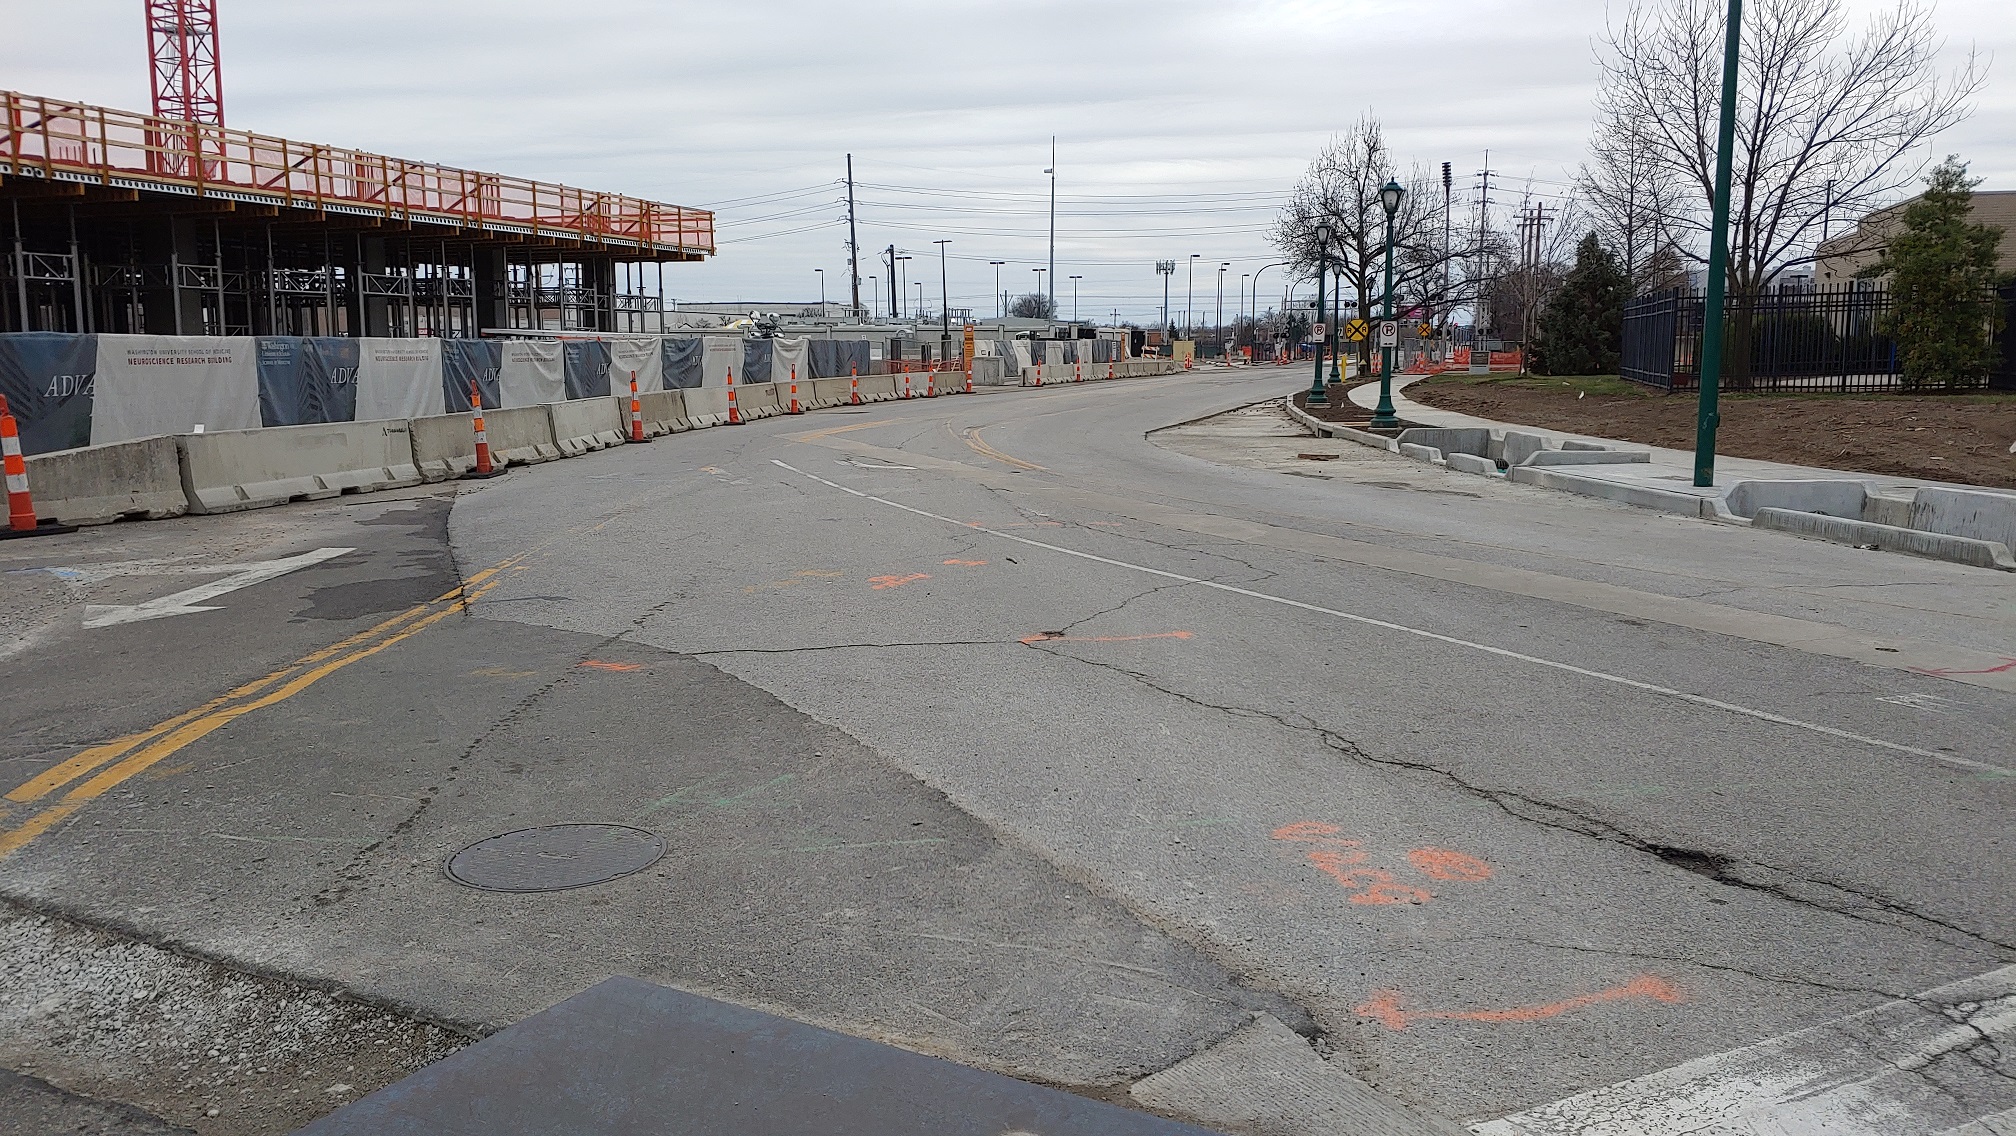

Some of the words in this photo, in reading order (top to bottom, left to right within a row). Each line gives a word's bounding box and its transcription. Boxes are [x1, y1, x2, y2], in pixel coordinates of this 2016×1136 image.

[127, 358, 174, 366] NEUROSCIENCE
[176, 357, 206, 365] RESEARCH
[207, 356, 232, 364] BUILDING
